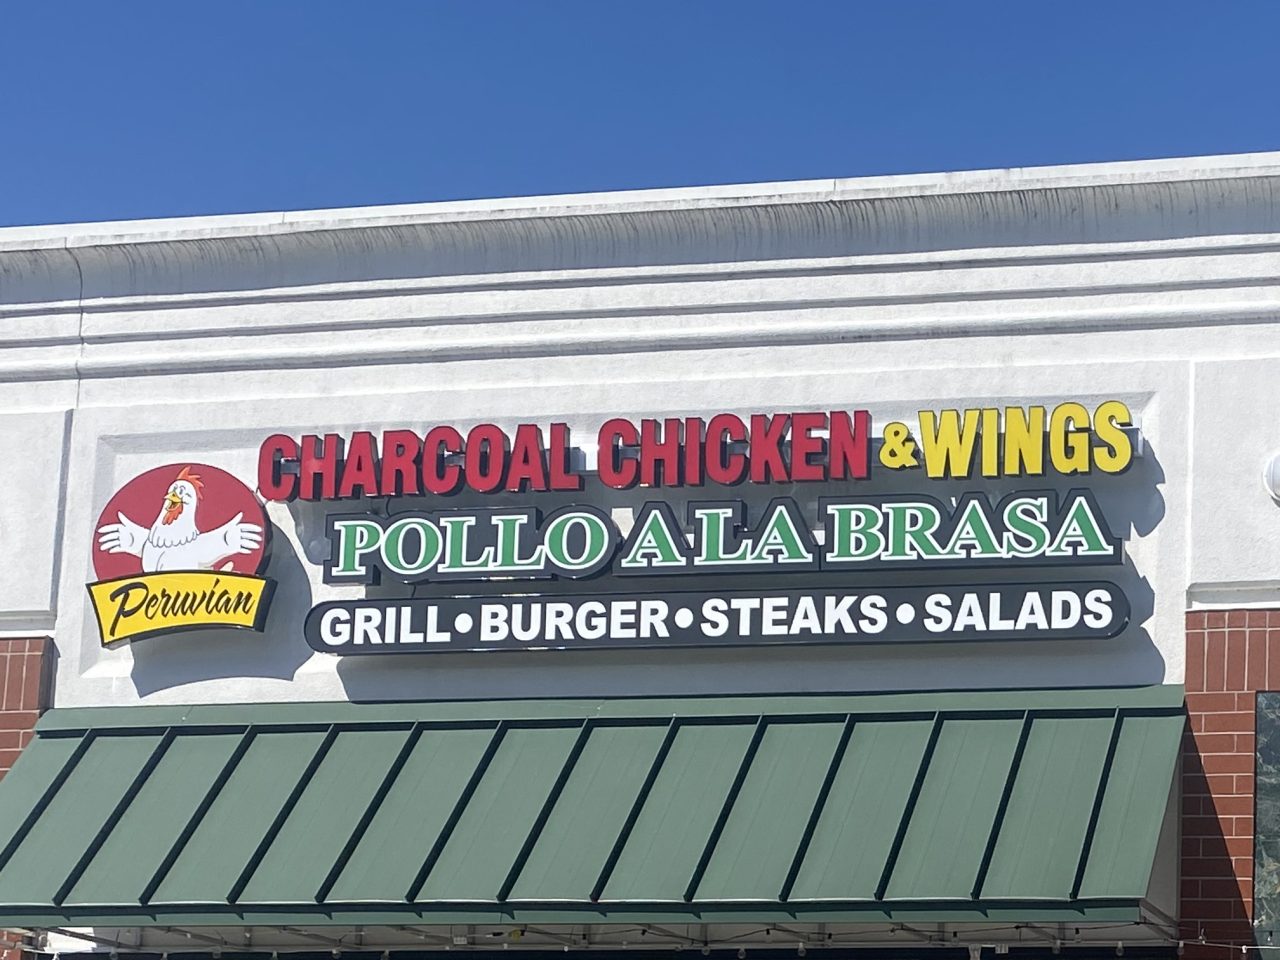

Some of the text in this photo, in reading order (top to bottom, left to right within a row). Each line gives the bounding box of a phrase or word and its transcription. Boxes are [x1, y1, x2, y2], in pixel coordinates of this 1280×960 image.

[258, 423, 581, 500] CHARCOAL
[598, 410, 869, 488] CHICKEN
[918, 401, 1132, 478] WINGS
[332, 496, 1114, 576] POLLO A LA BRASA
[109, 579, 255, 636] Peruvian
[320, 589, 1113, 646] GRILL BURGER STEAKS SALADS
